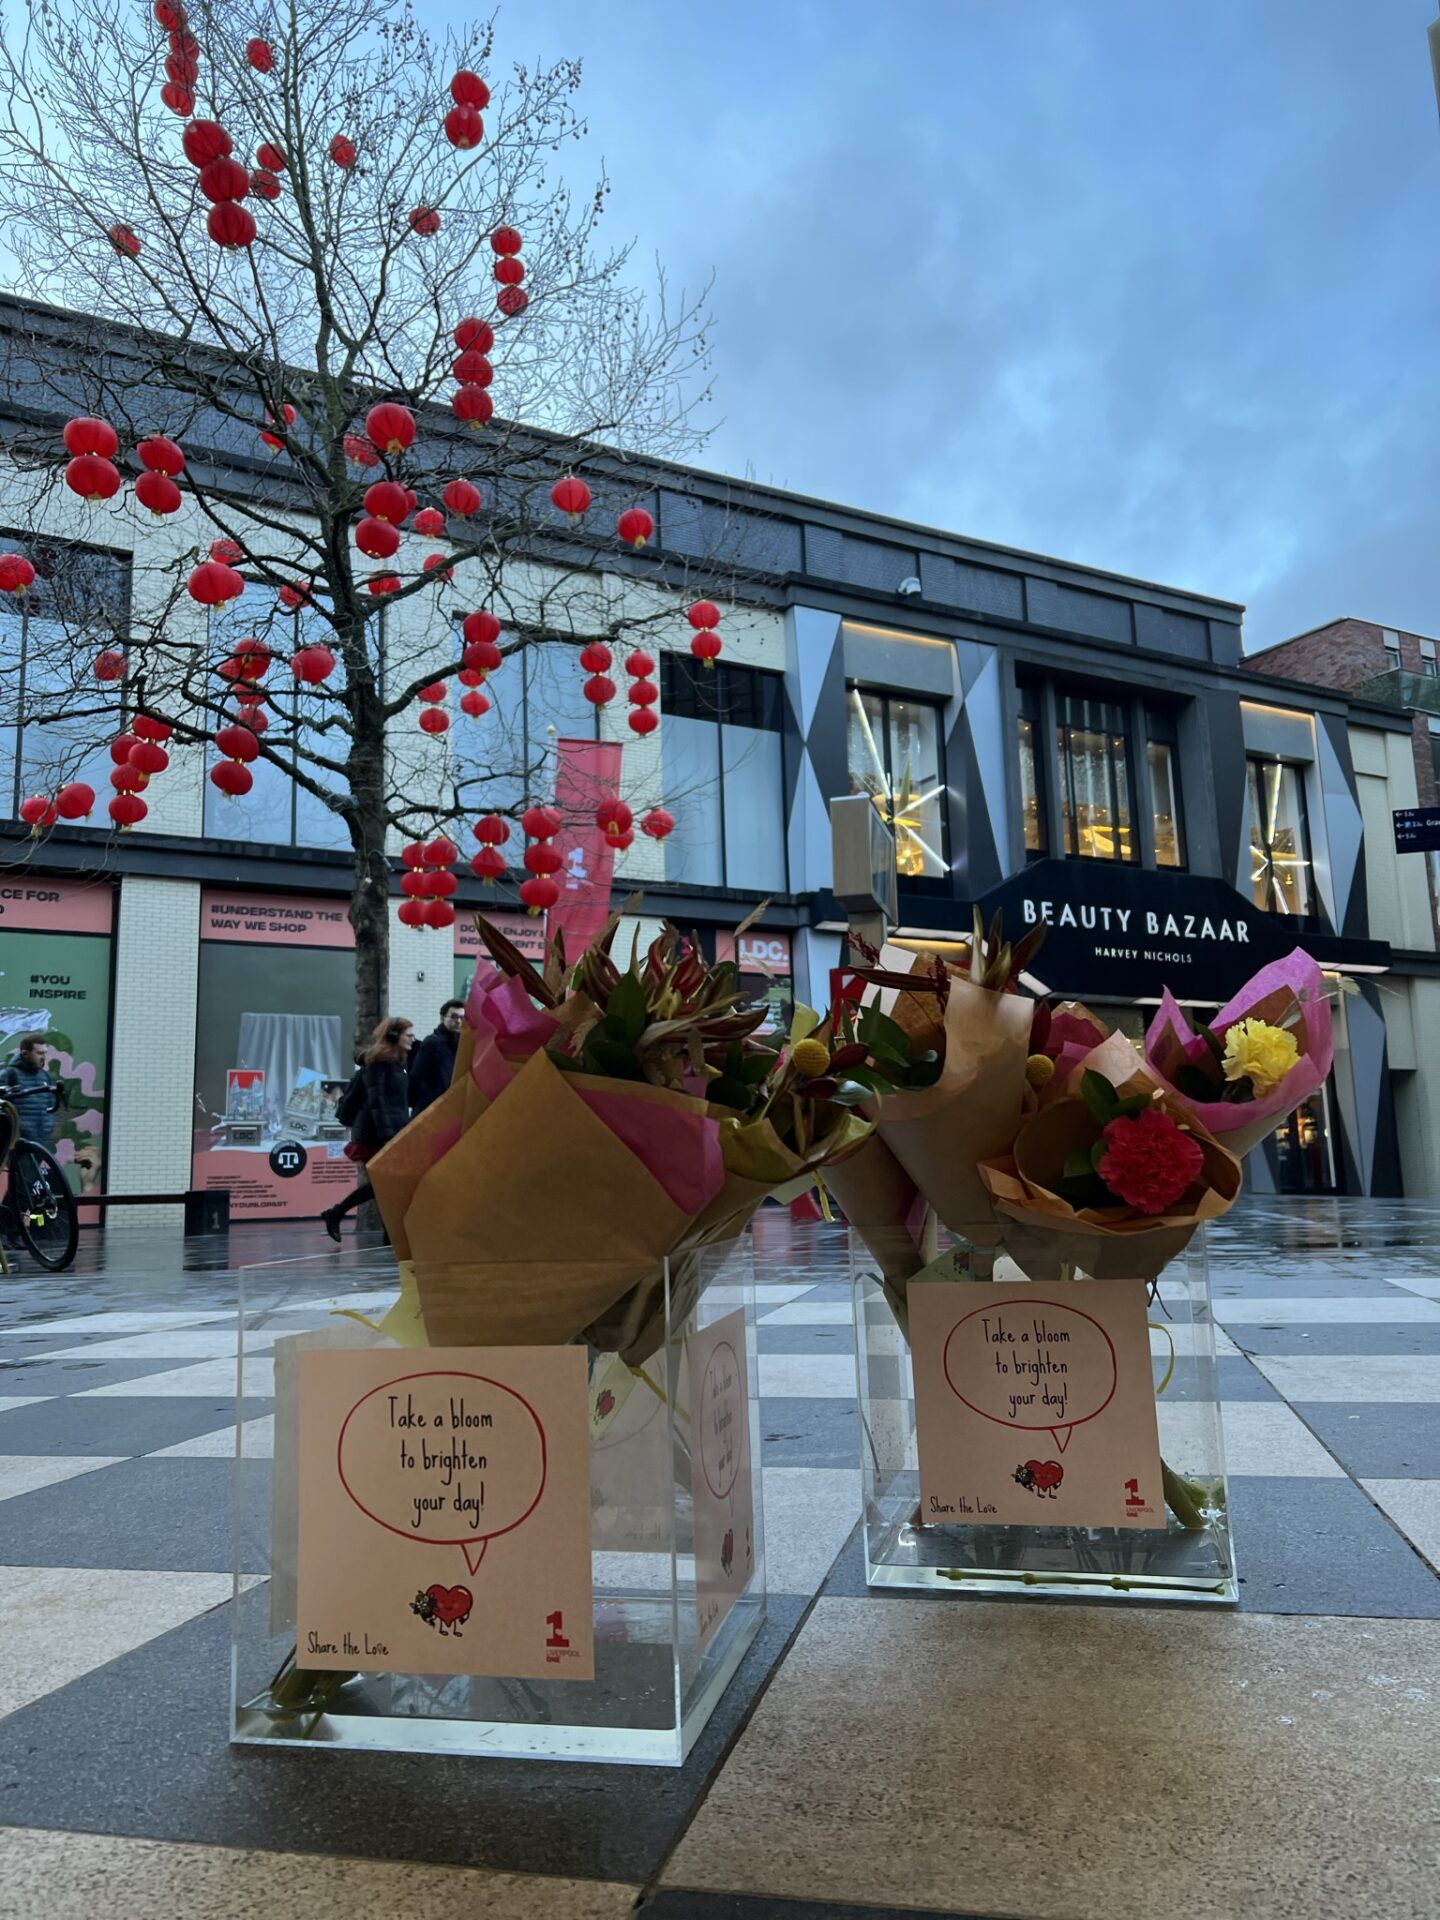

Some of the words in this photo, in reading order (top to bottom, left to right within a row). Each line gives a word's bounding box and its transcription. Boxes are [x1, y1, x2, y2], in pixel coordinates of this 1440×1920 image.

[26, 890, 60, 902] FOR
[211, 904, 314, 920] #UNDERSTAND
[316, 910, 343, 922] THE
[1023, 899, 1131, 932] BEAUTY
[1146, 911, 1250, 943] BAZAAR
[211, 918, 241, 929] WAY
[244, 920, 267, 931] WE
[269, 922, 306, 933] SHOP
[503, 927, 538, 937] ENJOY
[1095, 947, 1138, 960] HARVEY
[1144, 950, 1192, 964] NICHOLS
[30, 974, 70, 986] #YOU
[29, 988, 87, 1000] INSPIRE
[982, 1317, 1015, 1343] Take
[1021, 1333, 1030, 1343] a
[1033, 1319, 1070, 1344] bloom
[996, 1352, 1008, 1374] to
[1013, 1349, 1068, 1386] brighten
[1008, 1394, 1036, 1418] your
[1042, 1382, 1068, 1418] day!
[388, 1394, 427, 1428] Take
[434, 1416, 444, 1428] a
[450, 1398, 493, 1429] bloom
[400, 1439, 415, 1469] to
[422, 1437, 487, 1485] brighten
[411, 1497, 445, 1528] your
[453, 1482, 484, 1529] day!
[930, 1496, 956, 1513] Share
[959, 1495, 974, 1513] the
[977, 1497, 998, 1514] Love
[308, 1631, 338, 1654] Share
[343, 1631, 360, 1655] the
[364, 1633, 389, 1656] Love
